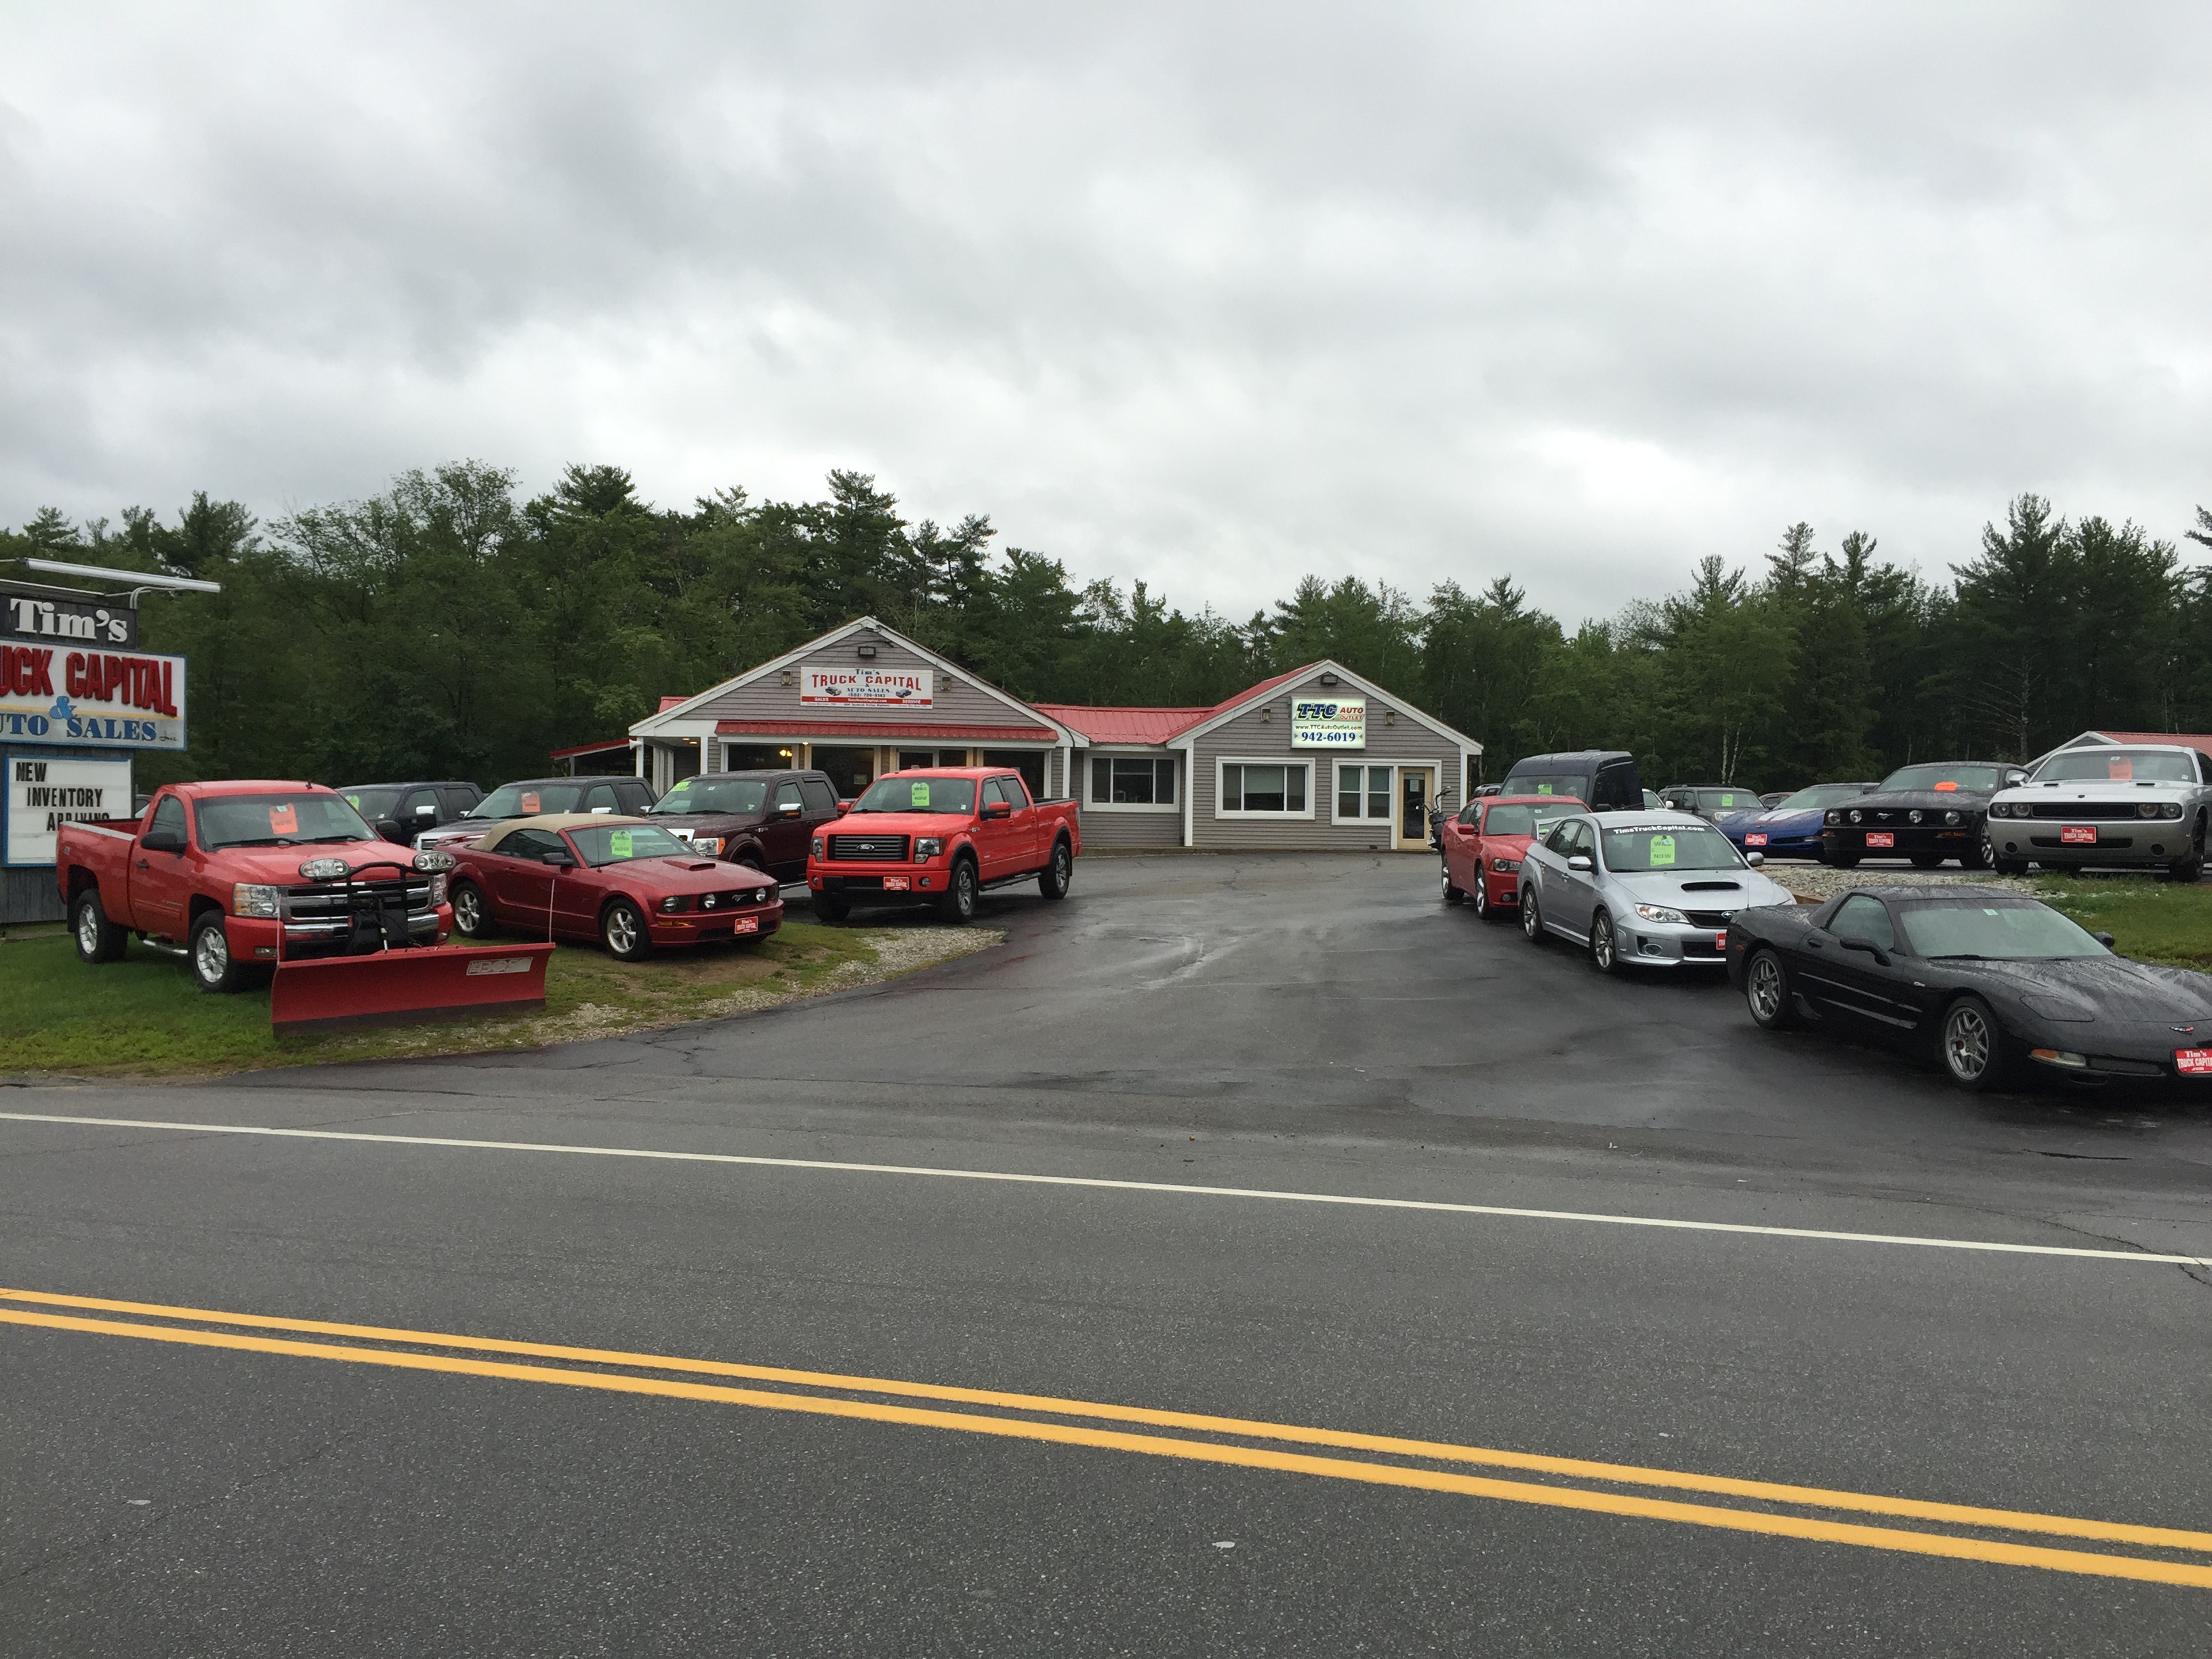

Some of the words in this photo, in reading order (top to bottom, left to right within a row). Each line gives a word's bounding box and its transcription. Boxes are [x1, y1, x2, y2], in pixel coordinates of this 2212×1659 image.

[10, 598, 127, 642] Tim's
[66, 652, 178, 717] CAPITAL
[812, 674, 857, 688] TRUCK
[865, 675, 922, 691] CAPITAL
[1297, 703, 1338, 718] TTC
[0, 713, 49, 736] TO
[66, 716, 157, 741] SALES
[1301, 732, 1356, 741] 942-6019
[16, 762, 47, 782] NEW
[27, 787, 103, 807] INVENTORY
[1614, 825, 1705, 834] TimsTruckCapital.com
[2177, 1058, 2195, 1069] TRUCK
